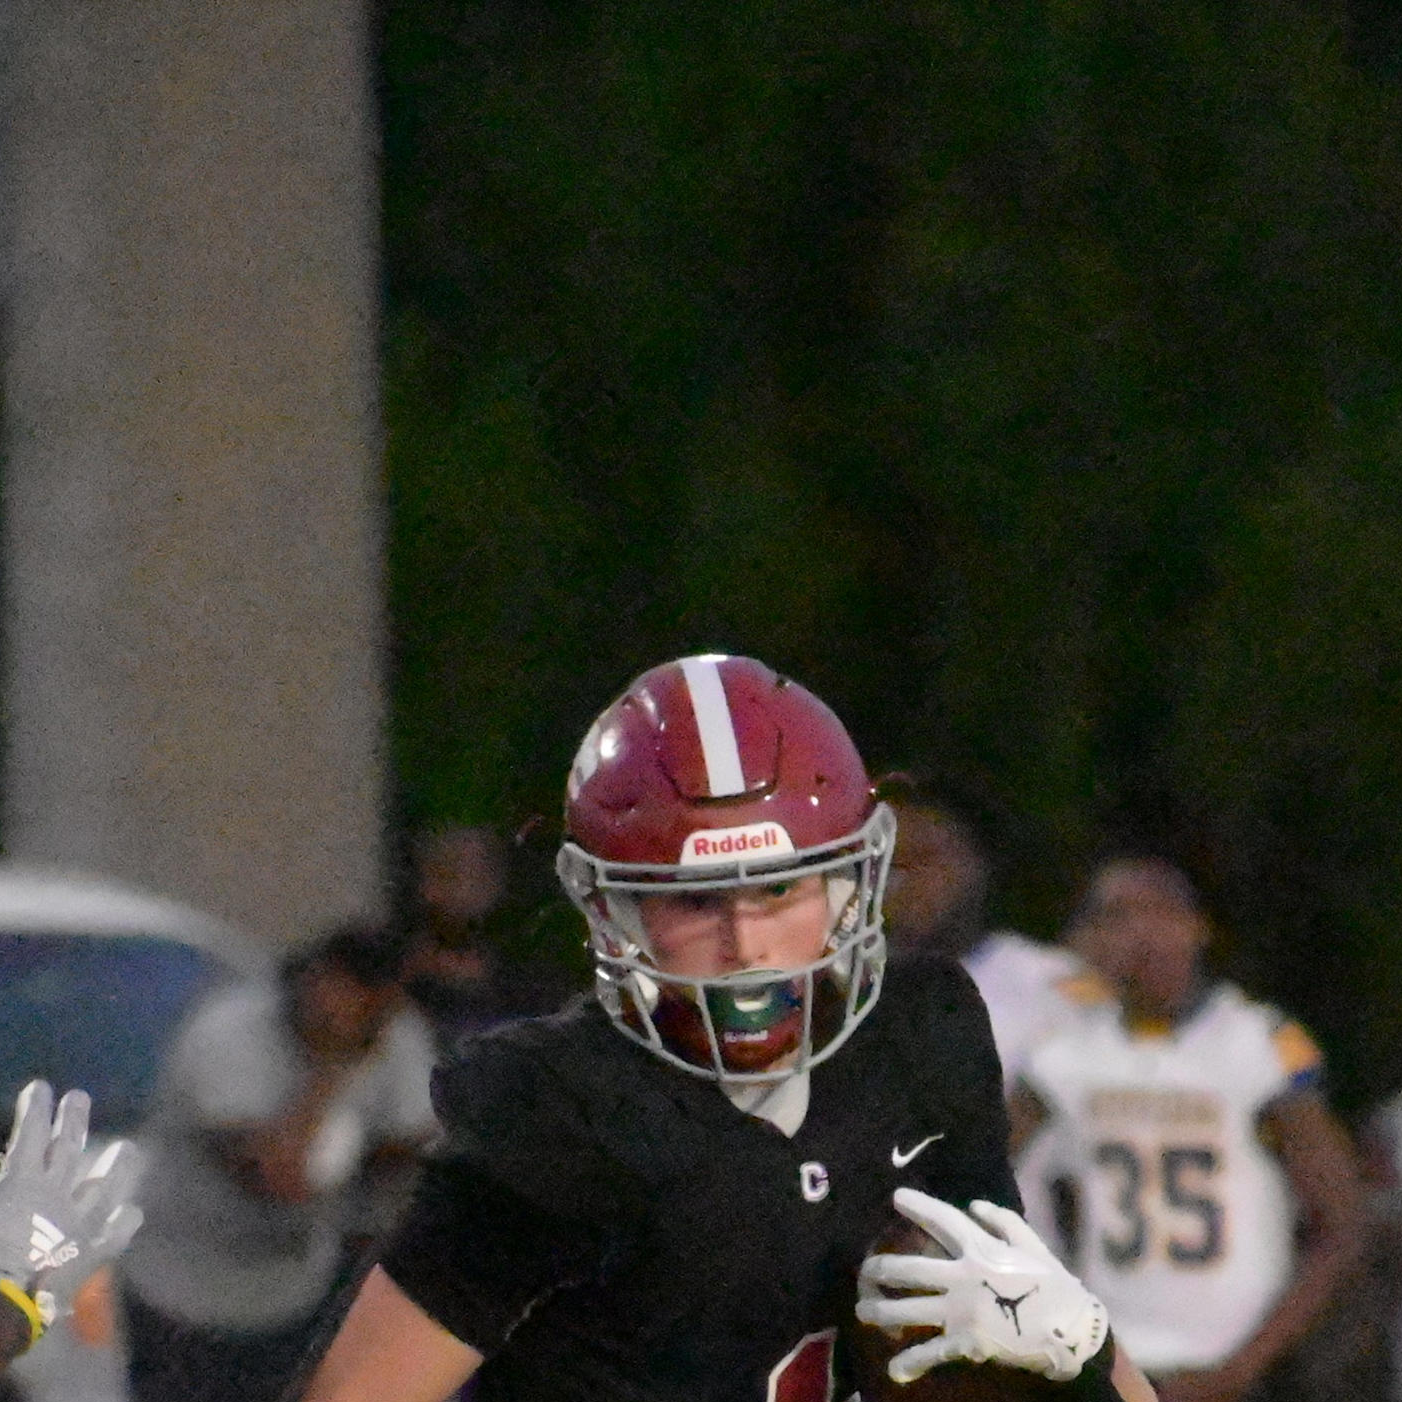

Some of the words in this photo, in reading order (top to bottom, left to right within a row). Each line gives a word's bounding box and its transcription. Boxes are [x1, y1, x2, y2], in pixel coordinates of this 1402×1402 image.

[692, 828, 779, 856] Riddell
[800, 1161, 830, 1201] C
[1092, 1136, 1230, 1270] 35
